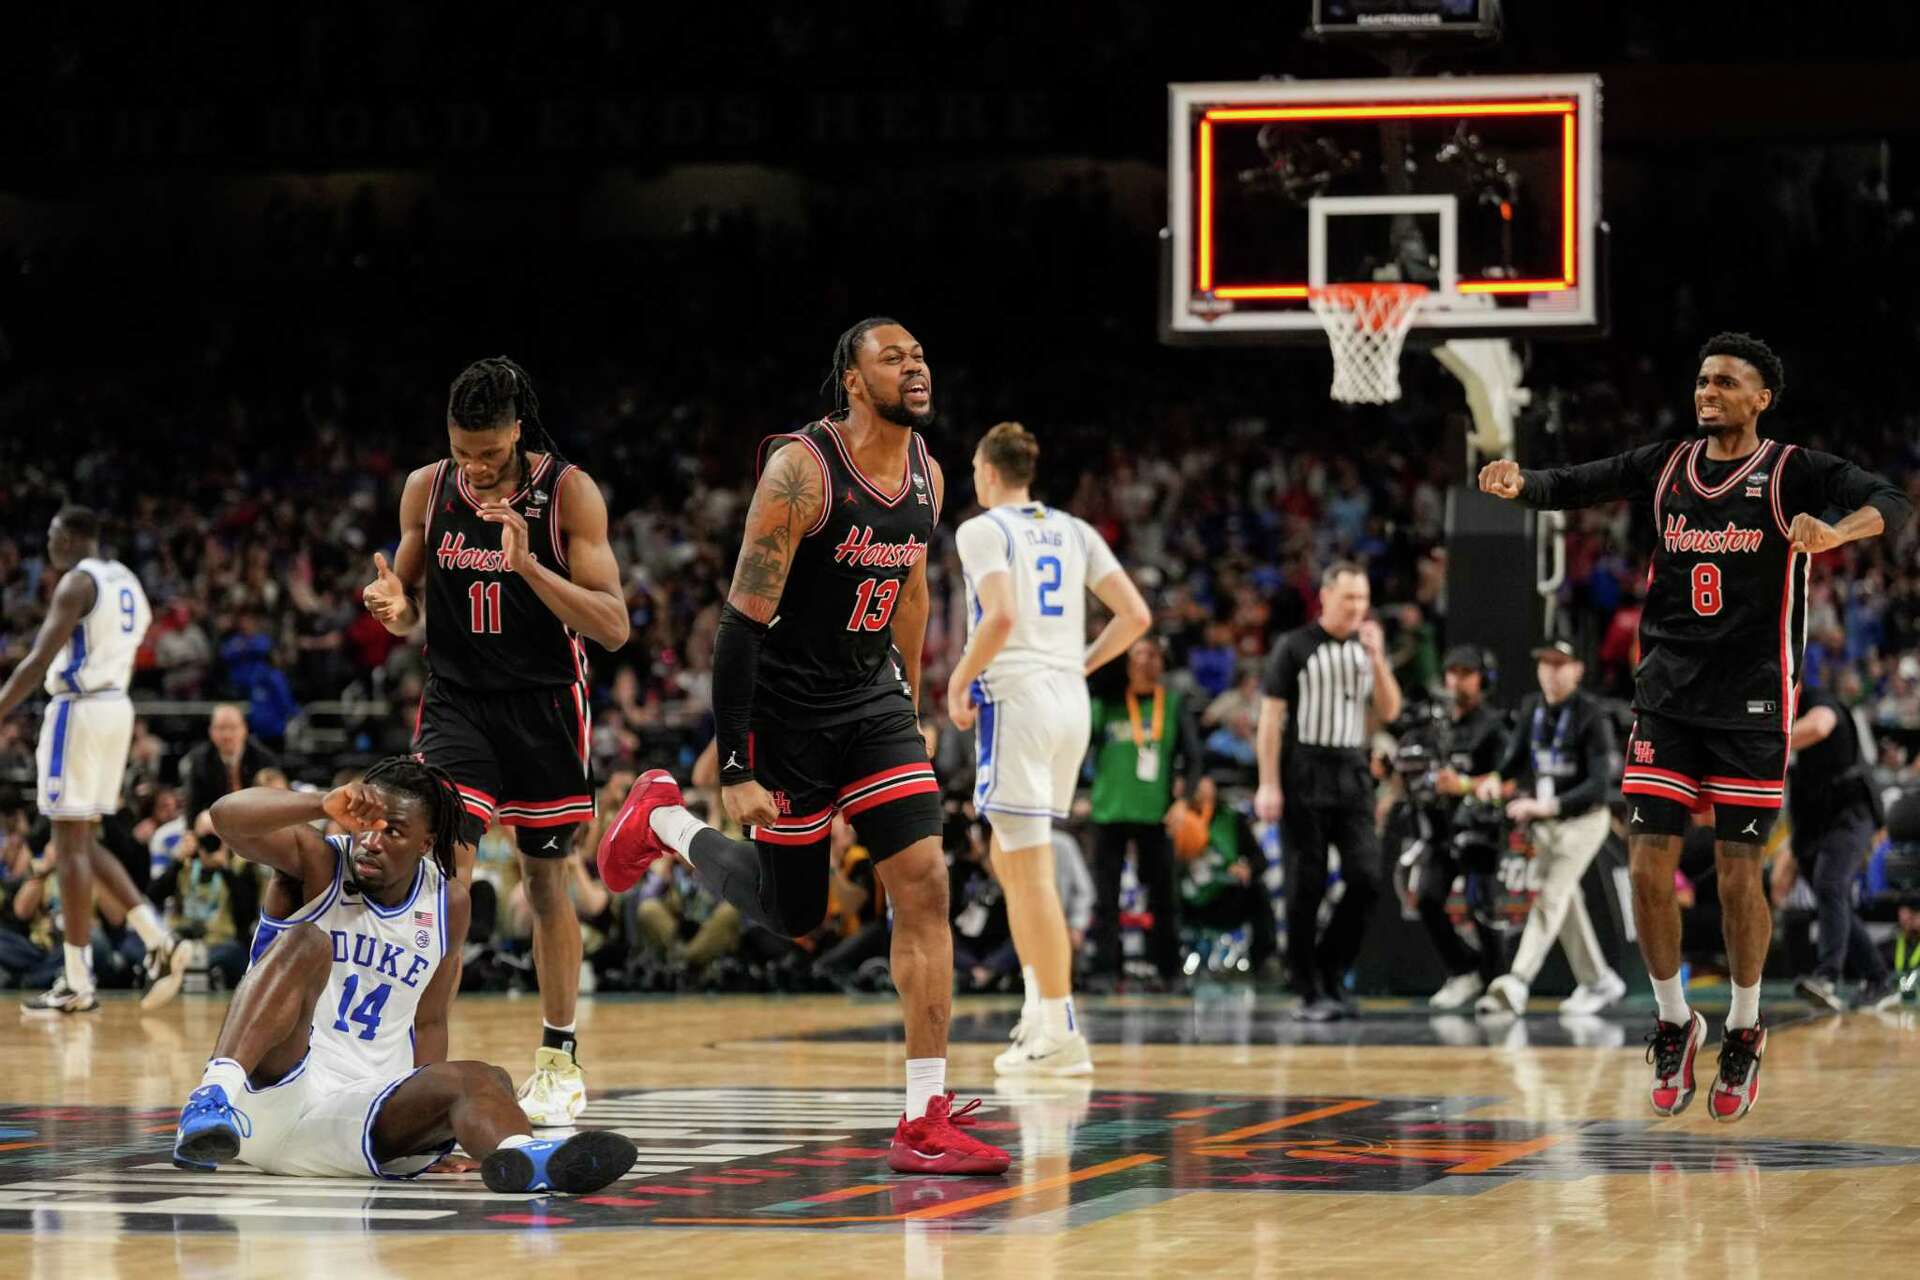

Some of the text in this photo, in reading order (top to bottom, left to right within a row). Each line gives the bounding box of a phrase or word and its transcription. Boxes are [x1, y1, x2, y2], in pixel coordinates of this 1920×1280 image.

[535, 94, 765, 149] ENDS
[804, 89, 1051, 144] HERE
[437, 531, 538, 573] Houst
[835, 524, 928, 568] Housto
[1664, 513, 1763, 554] Houston
[119, 588, 136, 633] 9
[468, 580, 502, 633] 11
[846, 577, 900, 631] 13
[1036, 555, 1064, 616] 2
[1691, 562, 1723, 616] 8
[330, 930, 429, 988] DUKE
[333, 973, 392, 1041] 14
